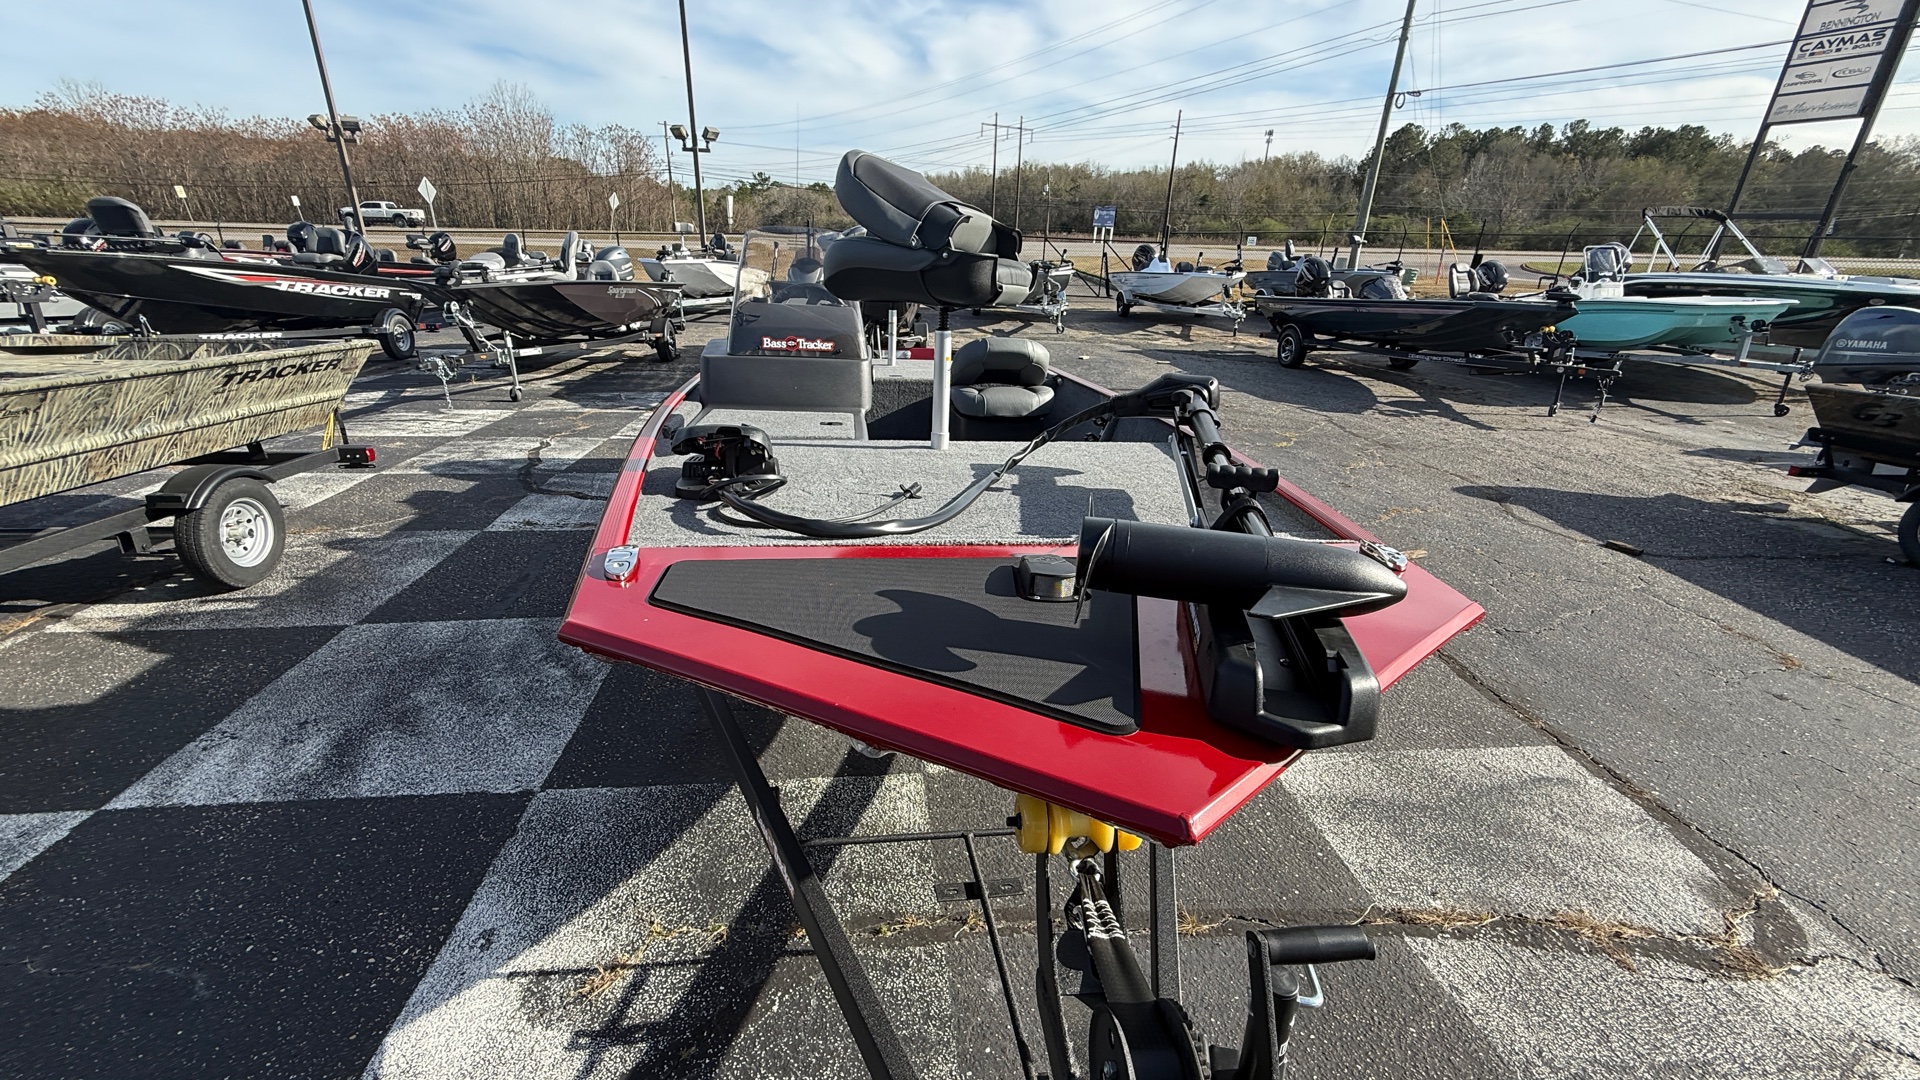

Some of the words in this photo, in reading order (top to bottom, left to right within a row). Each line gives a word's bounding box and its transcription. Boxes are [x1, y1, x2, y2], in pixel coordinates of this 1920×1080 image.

[1819, 11, 1881, 31] BENNINGTON
[1800, 28, 1888, 53] CAYMAS
[1851, 41, 1882, 51] BOATS
[275, 280, 391, 299] TRACKER
[199, 332, 283, 340] TRACKER
[763, 337, 787, 349] Bass
[796, 338, 834, 350] Tracker
[1846, 340, 1888, 350] YAMAHA
[221, 358, 343, 388] TRACKER
